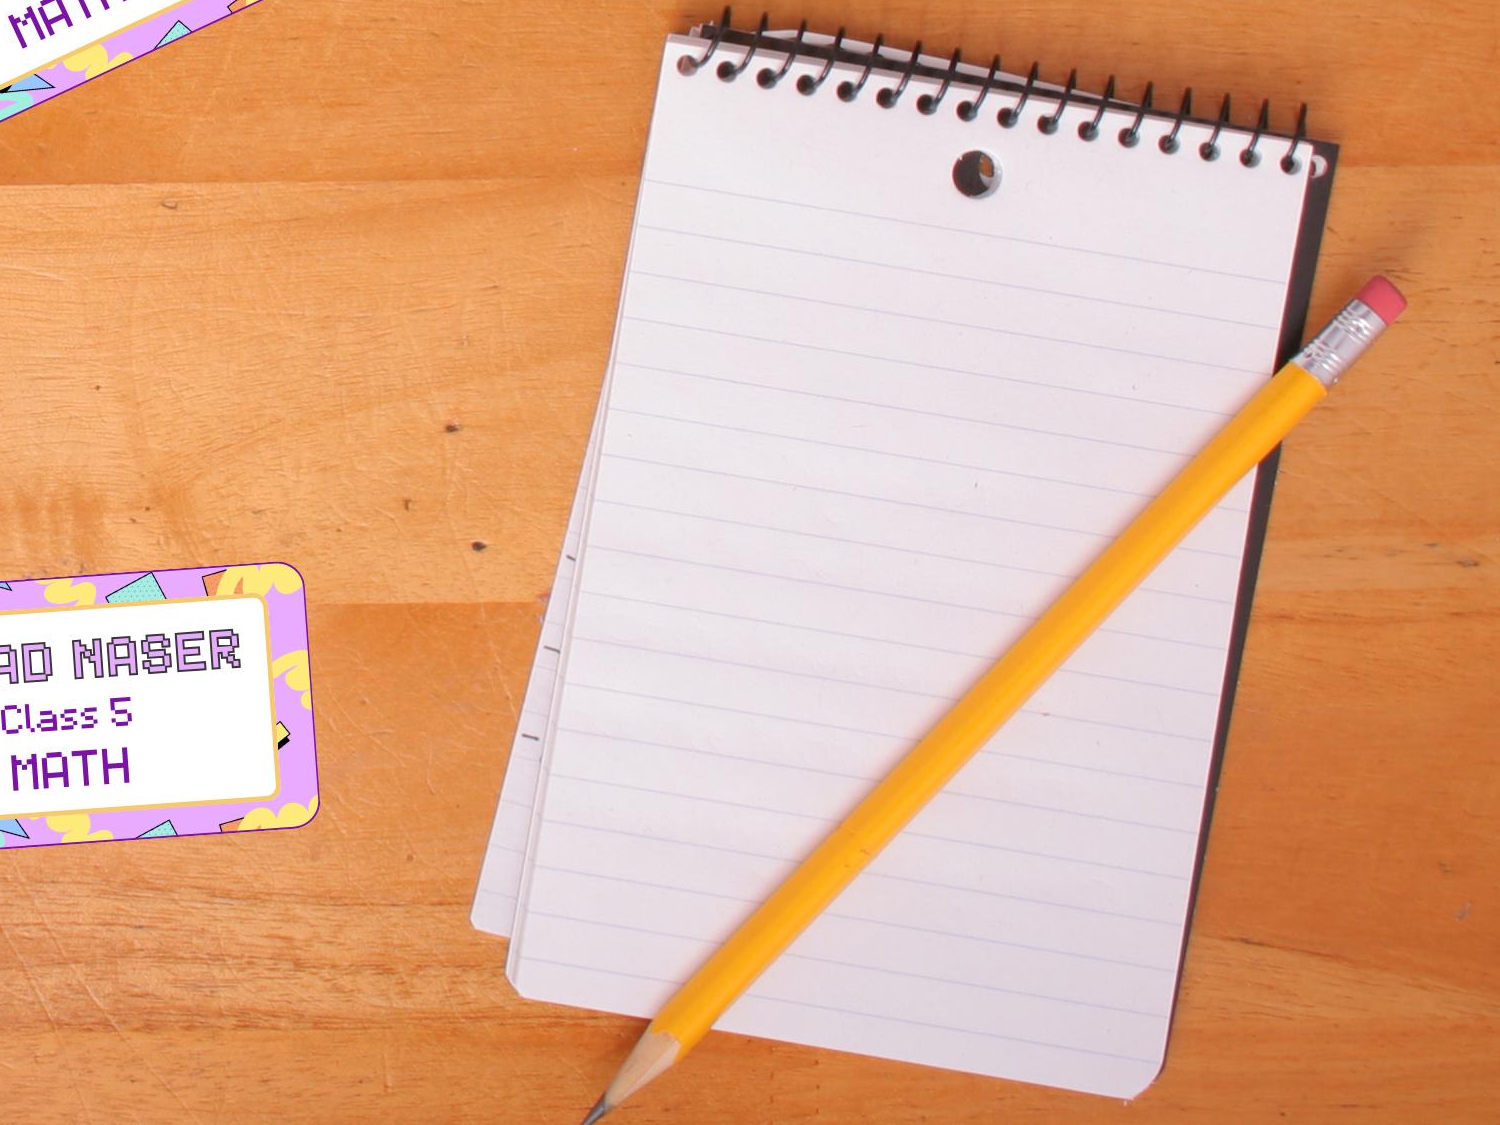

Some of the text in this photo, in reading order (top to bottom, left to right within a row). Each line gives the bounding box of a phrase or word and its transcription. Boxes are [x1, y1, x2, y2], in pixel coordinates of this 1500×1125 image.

[72, 629, 242, 680] NASER
[0, 696, 133, 735] Class 5
[10, 746, 130, 792] MATH
